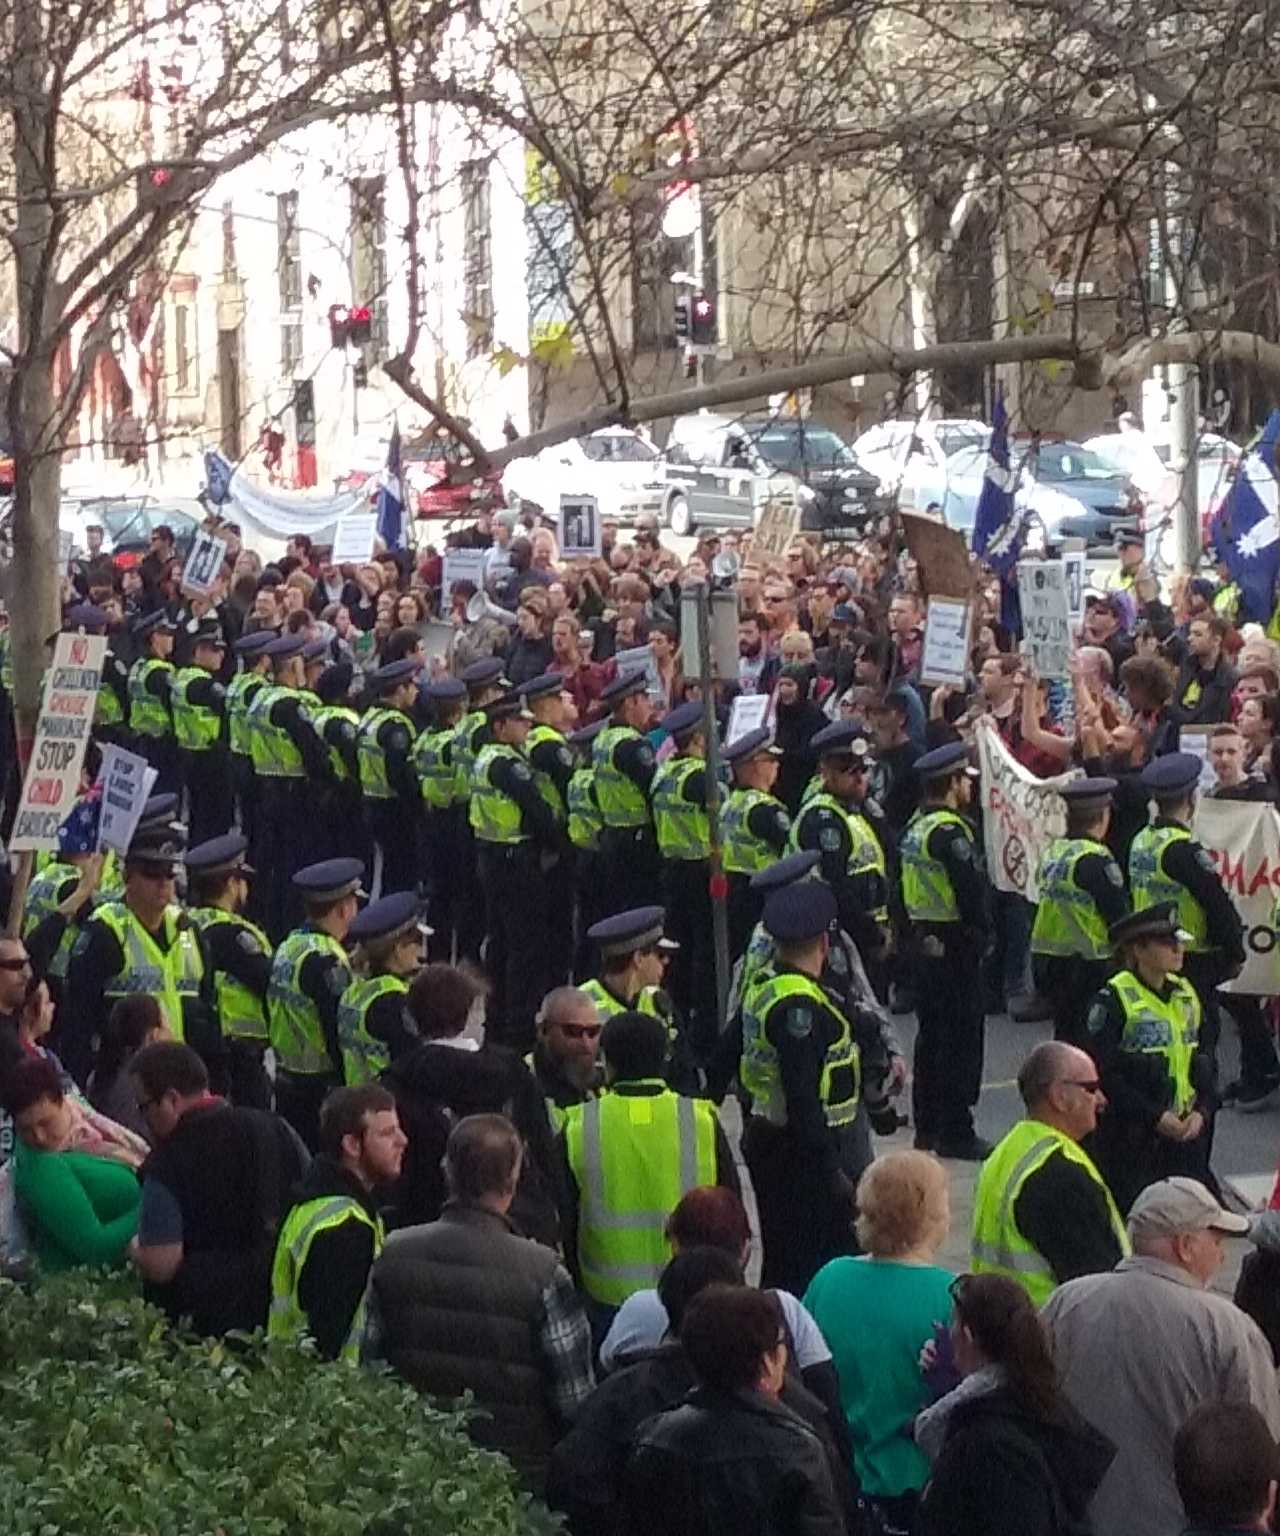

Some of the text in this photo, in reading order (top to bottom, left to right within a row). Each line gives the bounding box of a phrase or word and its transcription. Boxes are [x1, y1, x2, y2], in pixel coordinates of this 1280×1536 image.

[69, 639, 89, 666] NO
[36, 740, 76, 770] STOP
[27, 778, 63, 806] CHILD
